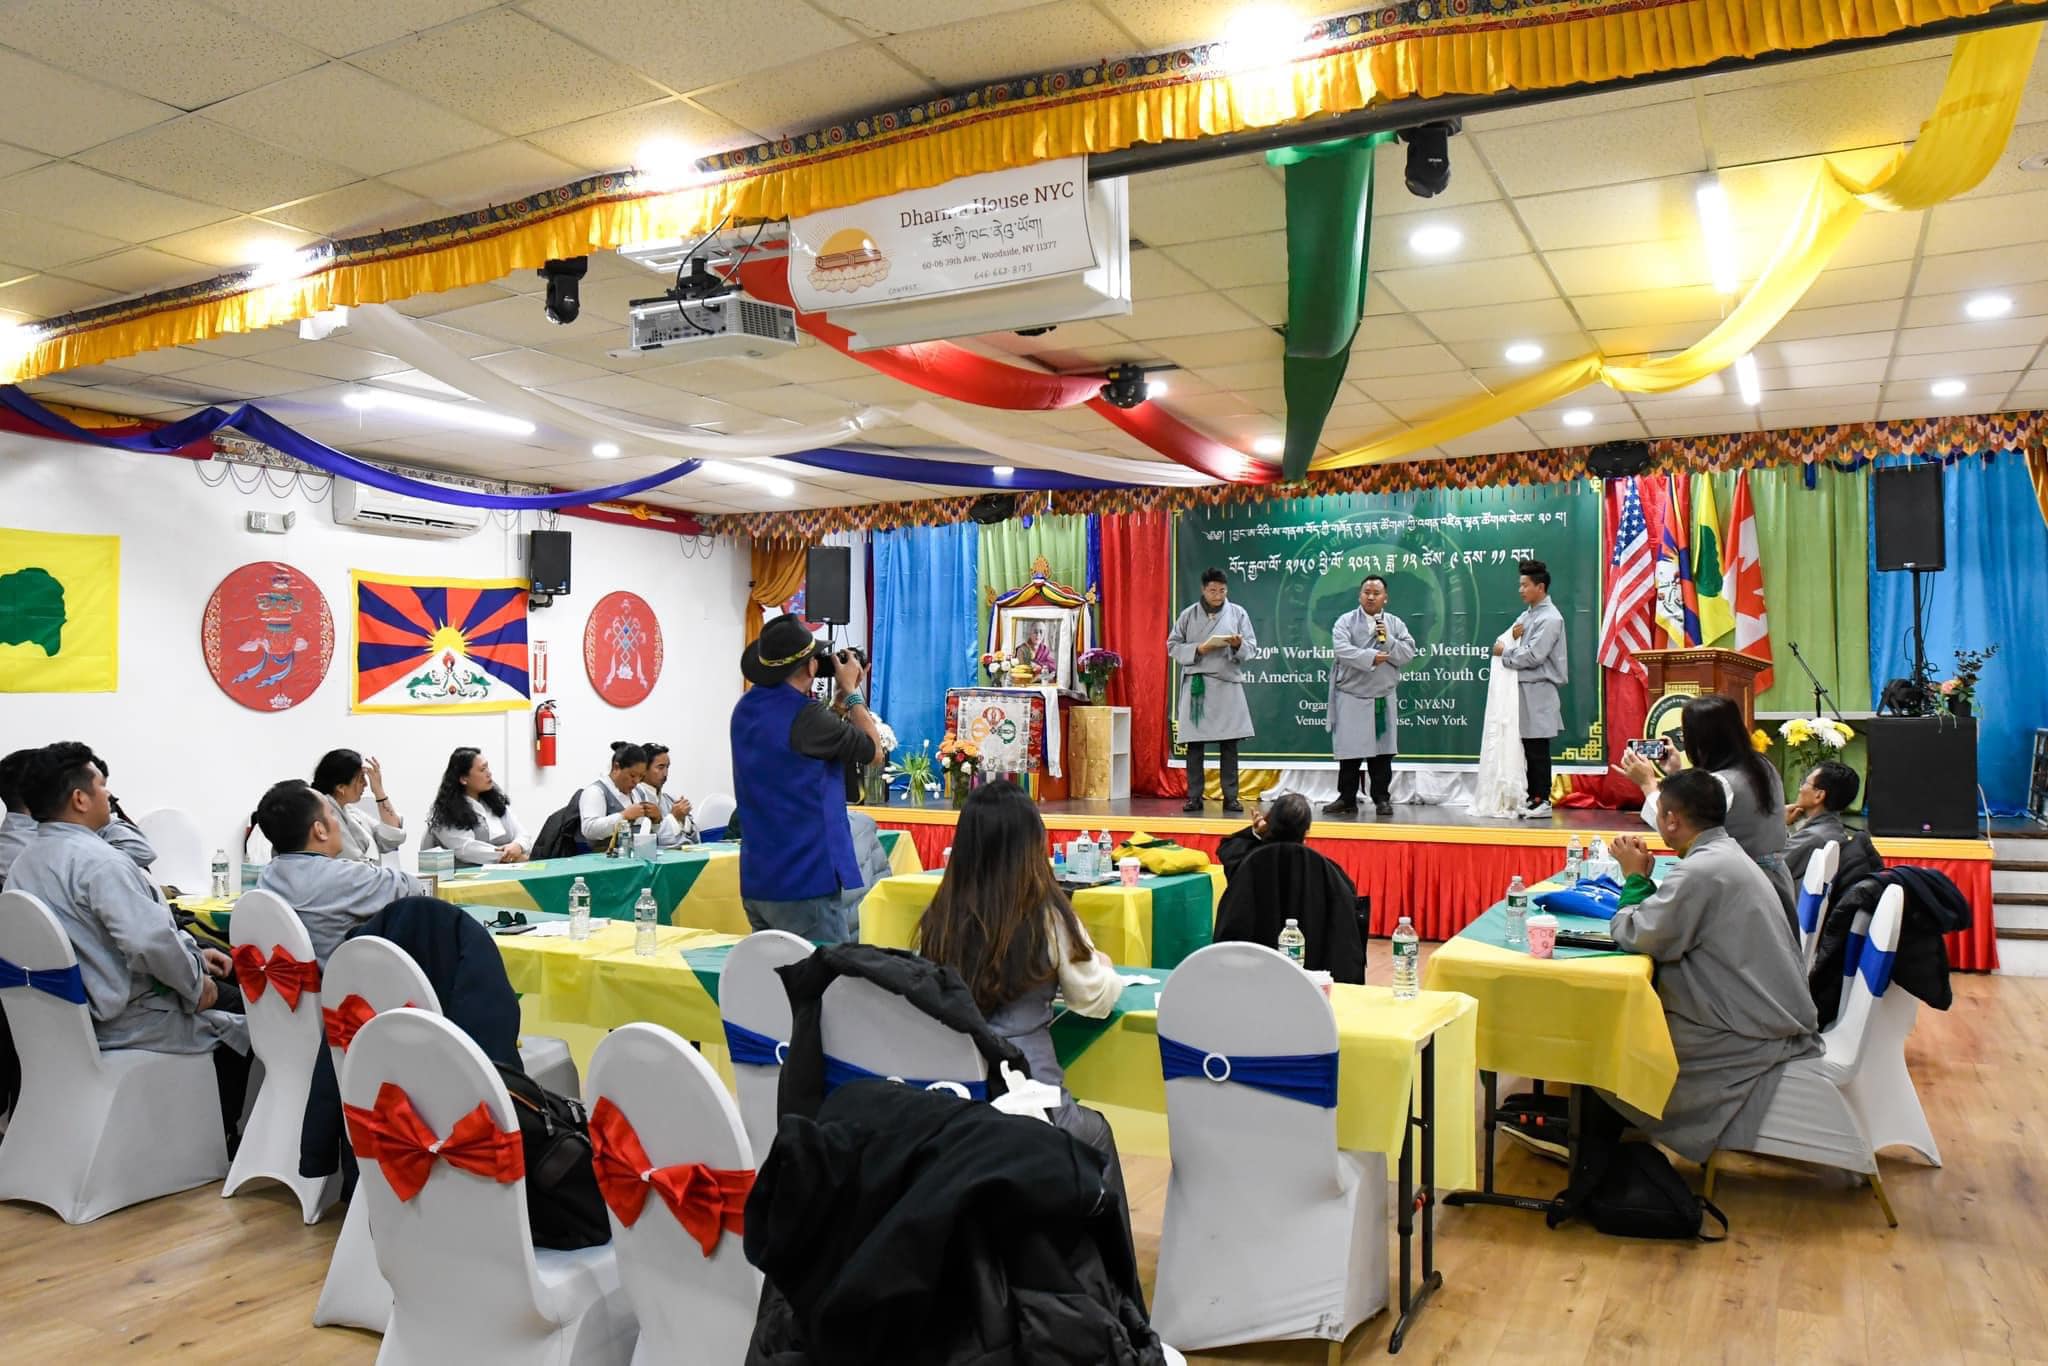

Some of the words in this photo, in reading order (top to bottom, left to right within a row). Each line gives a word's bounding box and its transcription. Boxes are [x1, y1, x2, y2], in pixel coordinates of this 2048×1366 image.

[973, 193, 1029, 215] House
[1034, 181, 1074, 203] NYC
[982, 247, 1021, 260] Woodside,
[1022, 245, 1034, 254] NY
[1036, 240, 1057, 251] 11377
[1255, 646, 1279, 660] 20th
[1282, 646, 1334, 659] Workin
[1430, 643, 1490, 660] Meeting
[1258, 670, 1312, 683] America
[1433, 667, 1474, 681] Youth
[1414, 698, 1455, 710] NY&NJ
[1417, 715, 1439, 726] New
[1441, 715, 1468, 726] York
